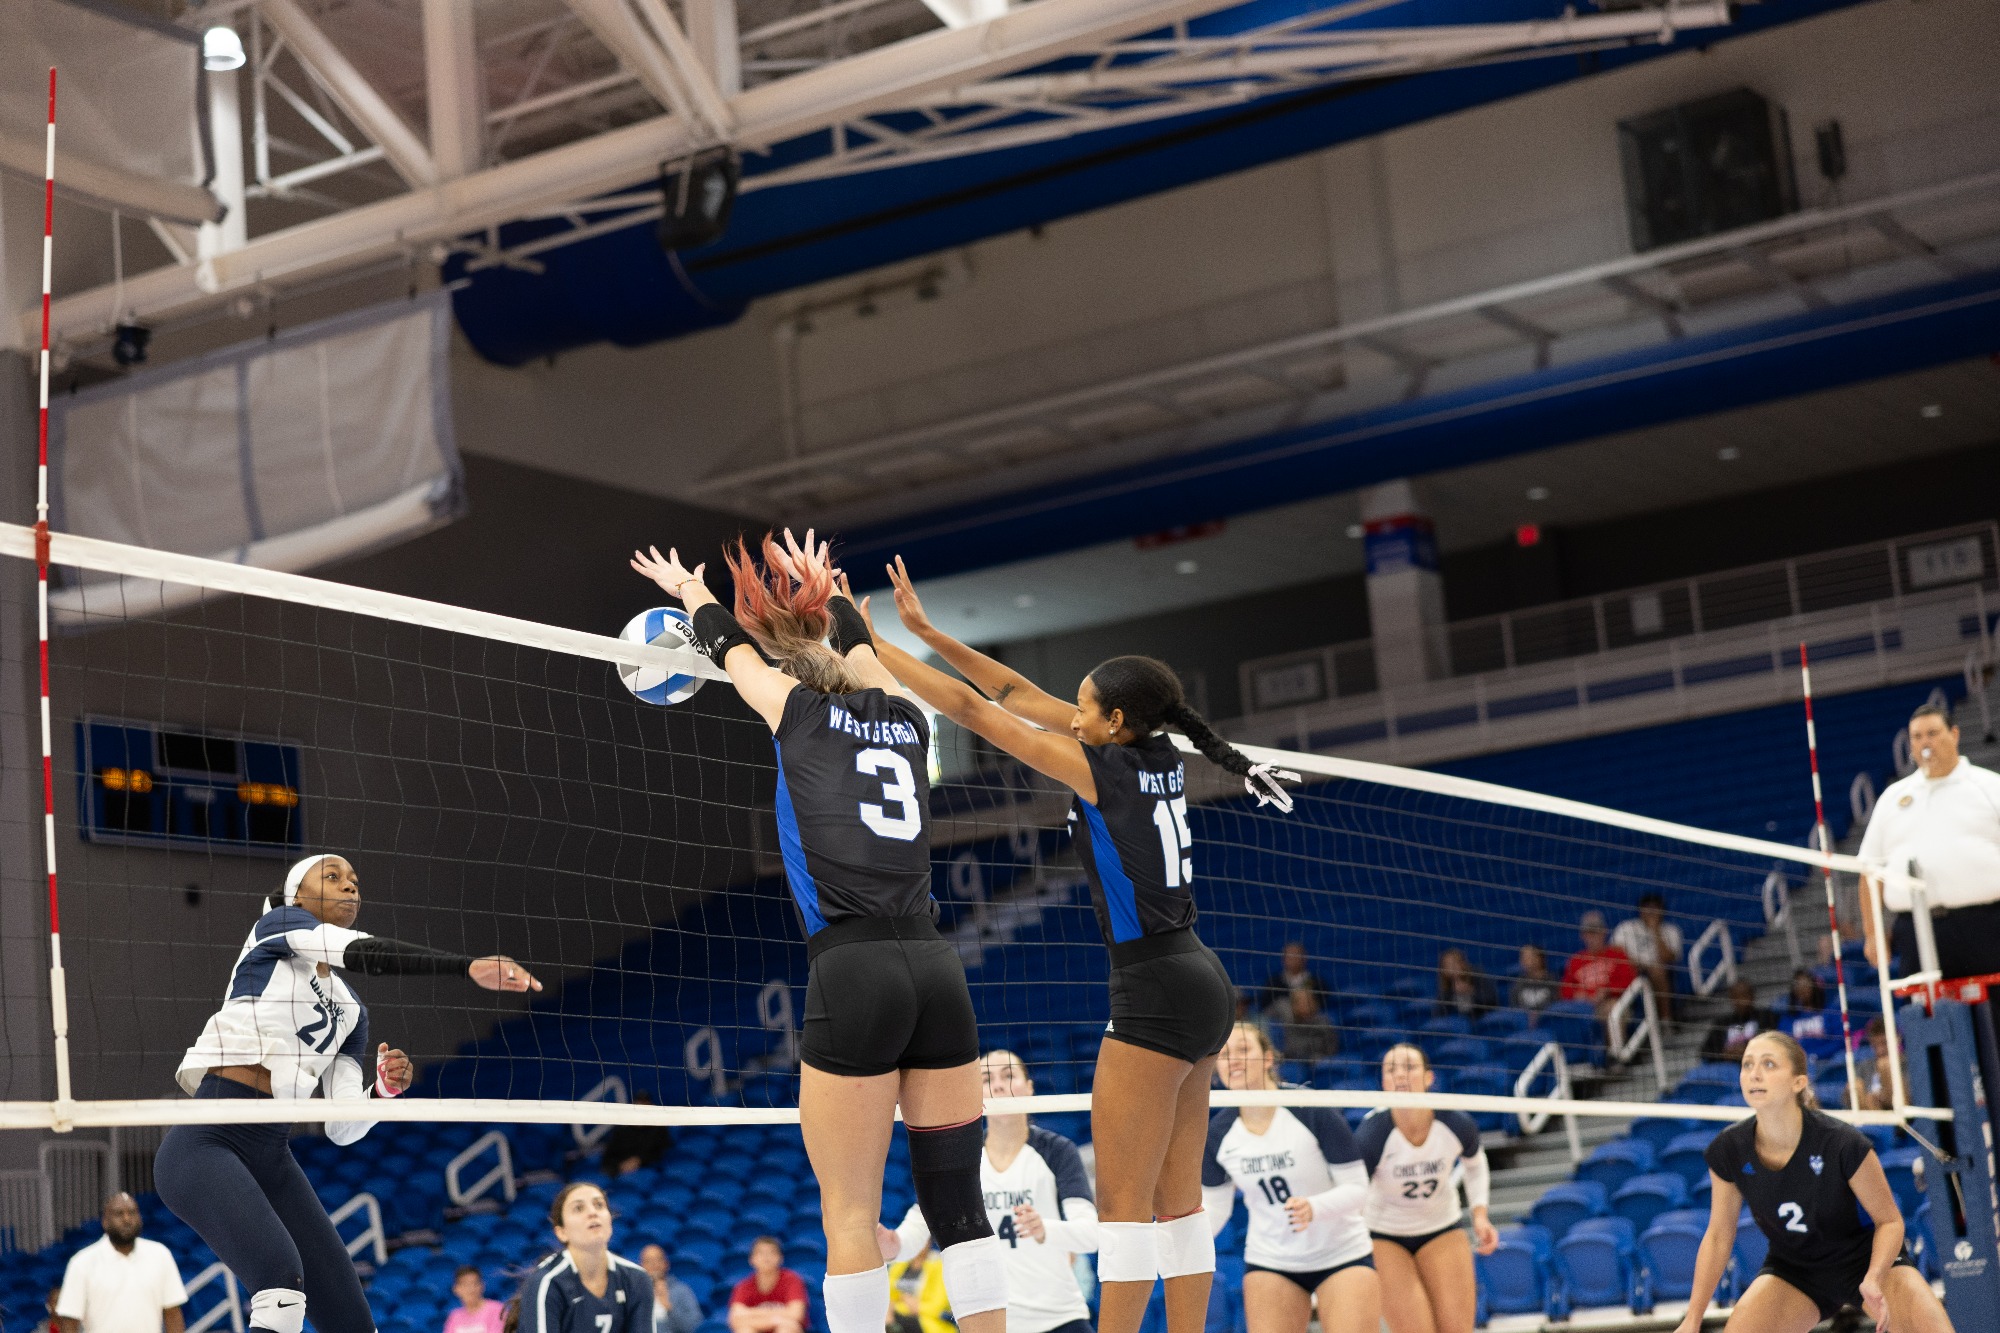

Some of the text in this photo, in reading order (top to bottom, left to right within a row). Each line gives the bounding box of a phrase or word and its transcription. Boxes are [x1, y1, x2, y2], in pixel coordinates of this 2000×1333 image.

[675, 621, 711, 656] olten
[829, 704, 870, 740] WEST
[855, 747, 922, 842] 3
[1152, 794, 1193, 888] 15
[295, 1002, 338, 1055] 21
[1257, 1174, 1292, 1205] 18
[1402, 1178, 1439, 1199] 23
[998, 1214, 1017, 1249] 4
[1777, 1201, 1809, 1233] 2
[594, 1313, 613, 1333] 7
